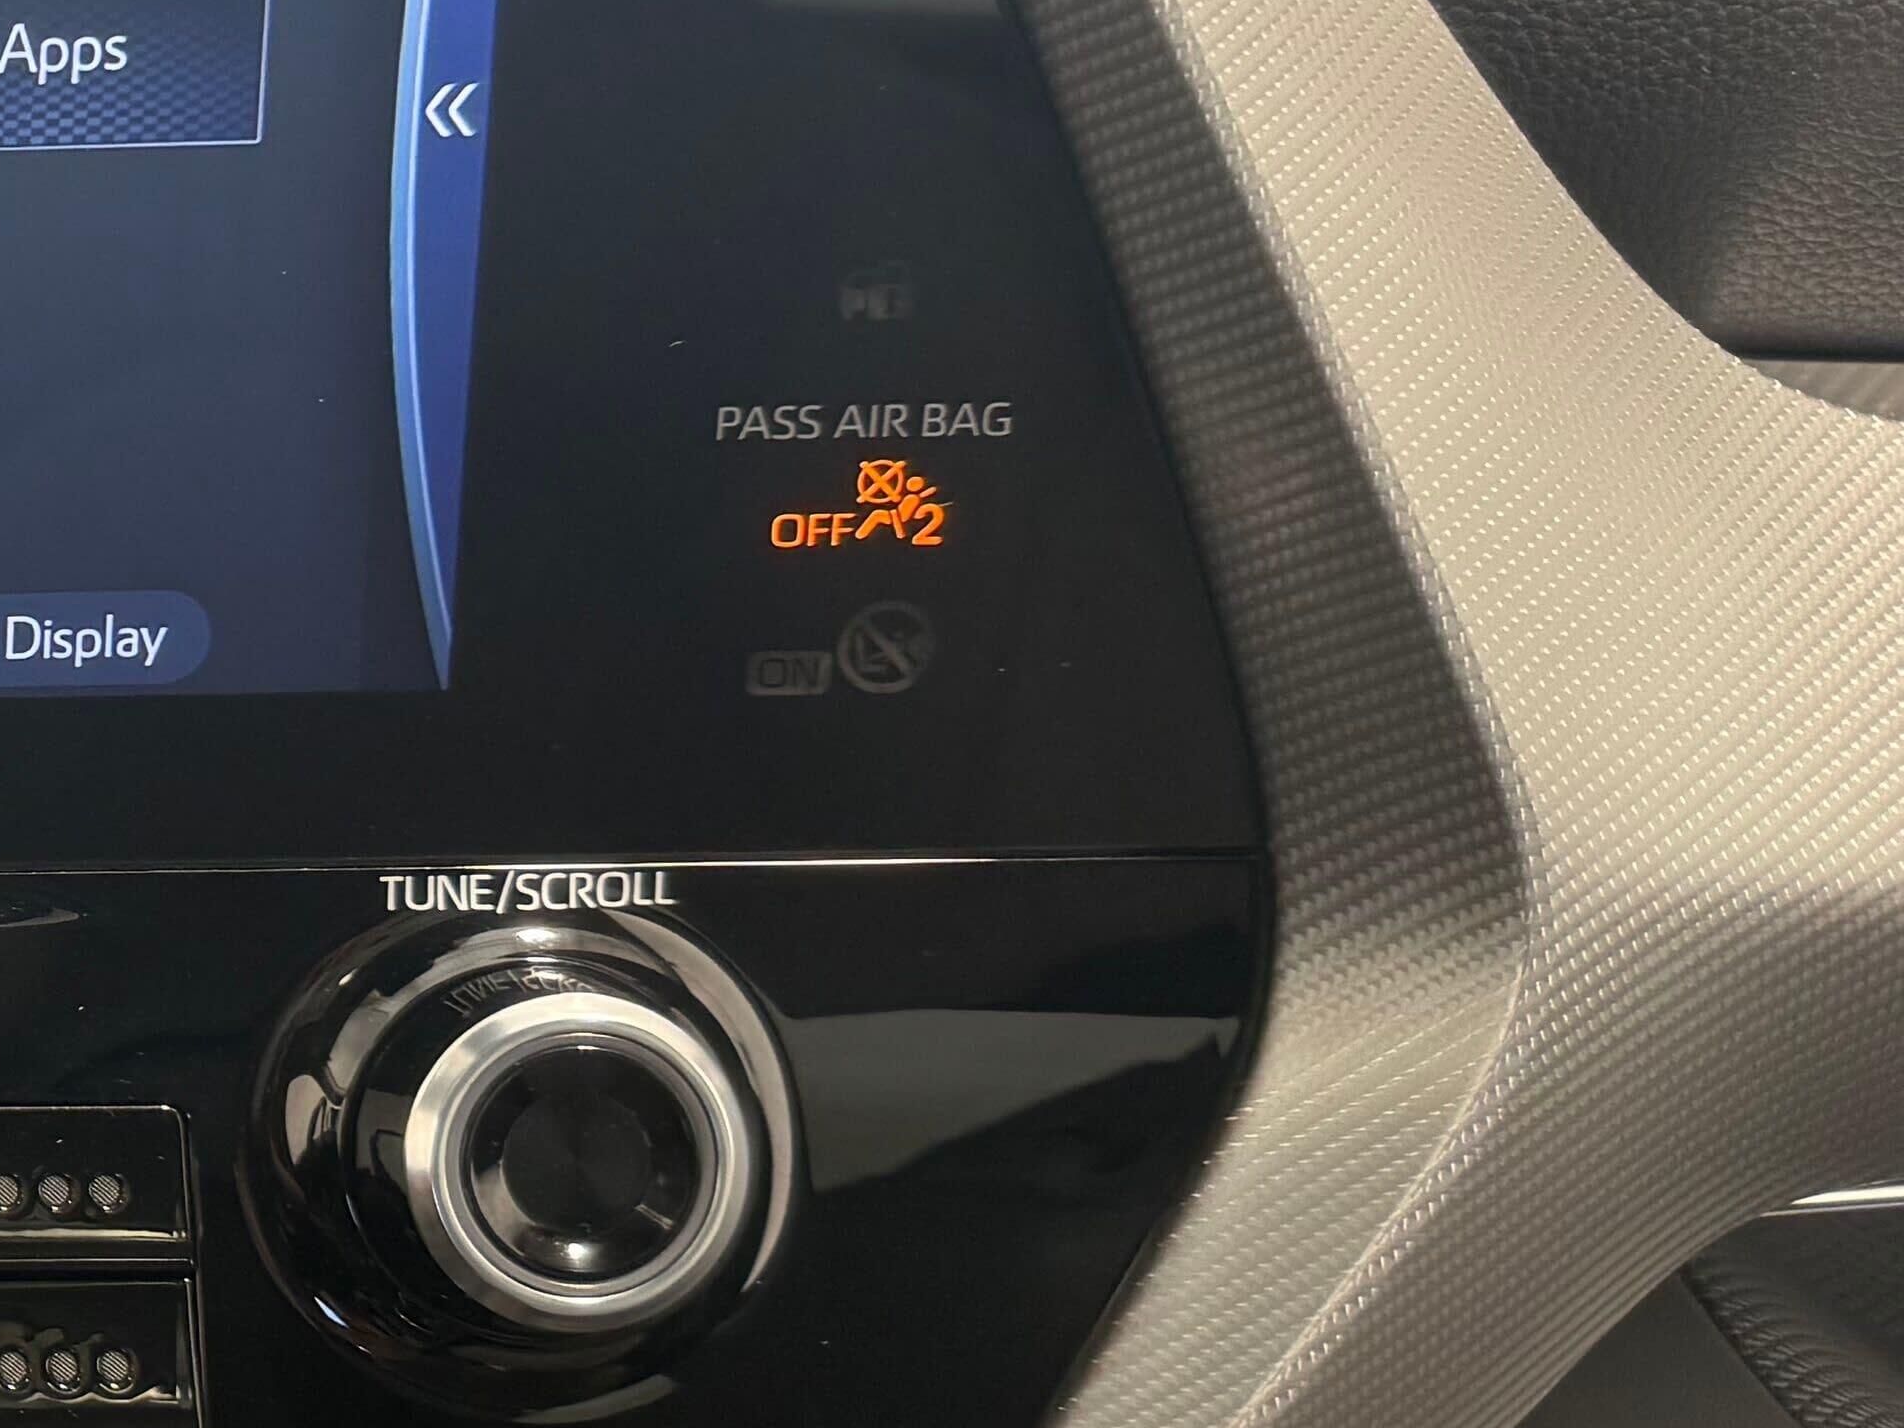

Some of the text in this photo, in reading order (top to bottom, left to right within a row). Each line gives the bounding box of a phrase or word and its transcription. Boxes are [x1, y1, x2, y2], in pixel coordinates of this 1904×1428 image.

[714, 400, 1014, 441] PASS AIR BAG
[769, 511, 857, 550] OFF
[3, 614, 169, 671] Display
[378, 867, 677, 916] TUNE/SCROLL
